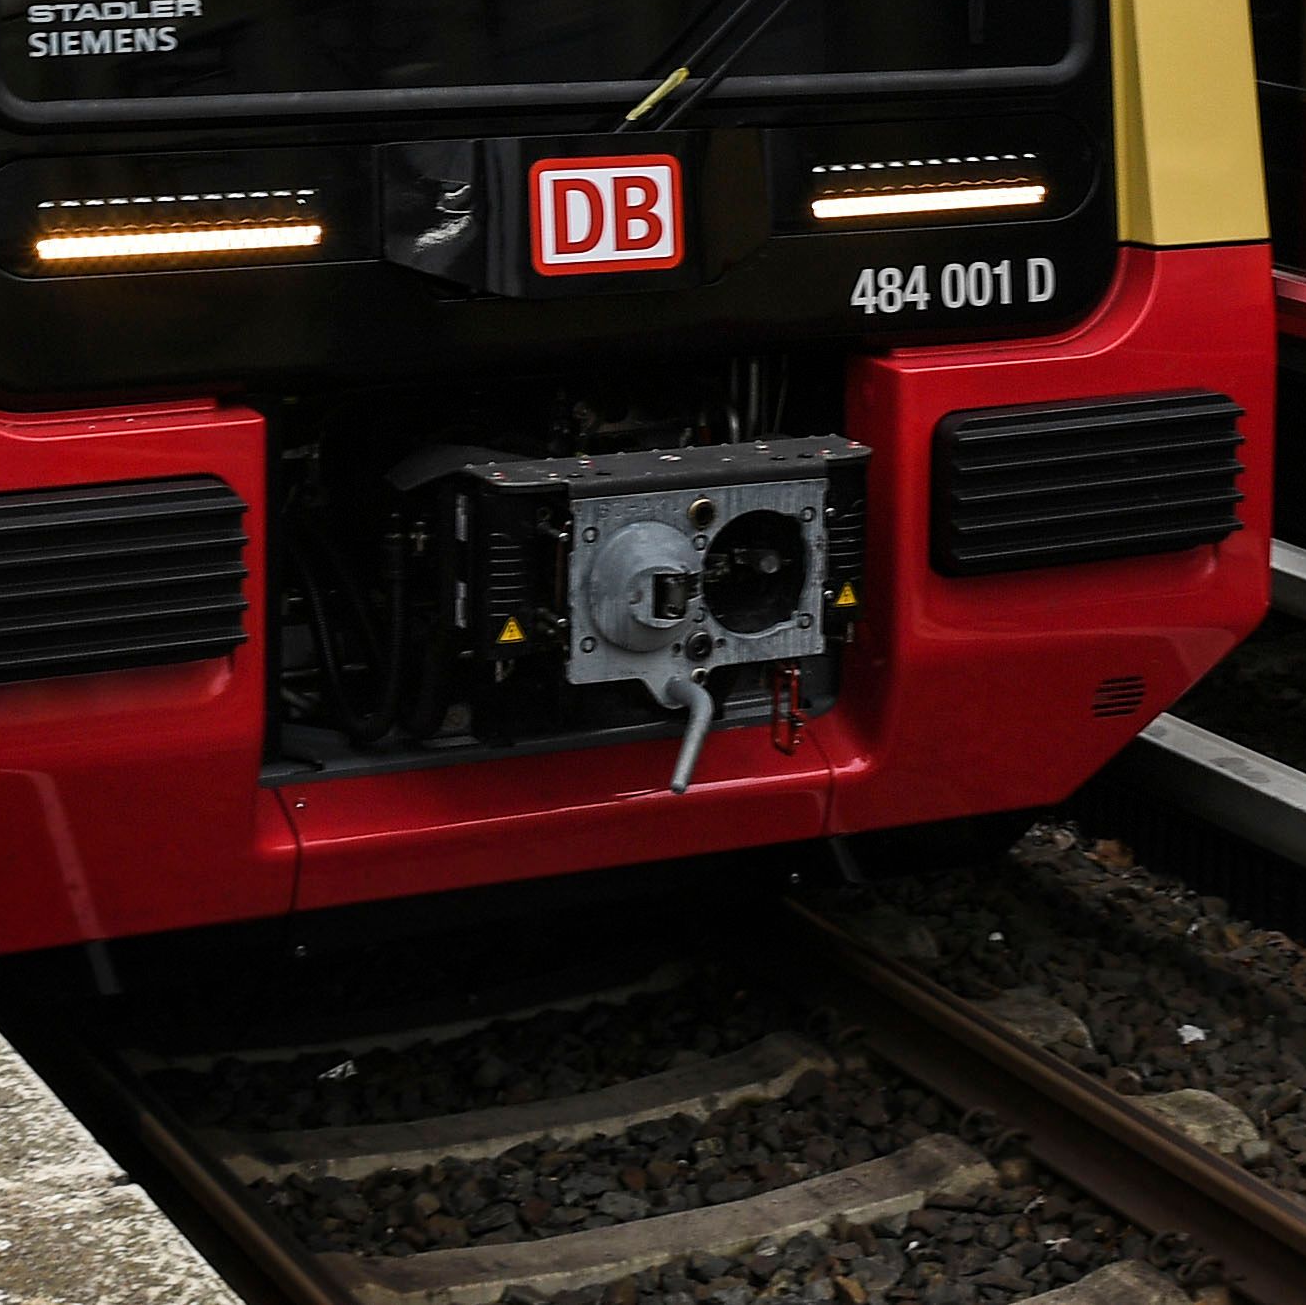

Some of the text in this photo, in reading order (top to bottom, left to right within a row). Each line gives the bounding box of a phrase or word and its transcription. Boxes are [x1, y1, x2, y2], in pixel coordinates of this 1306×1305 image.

[28, 26, 179, 58] SIEMENS
[552, 175, 664, 255] DB
[850, 257, 1057, 314] 484 001 D
